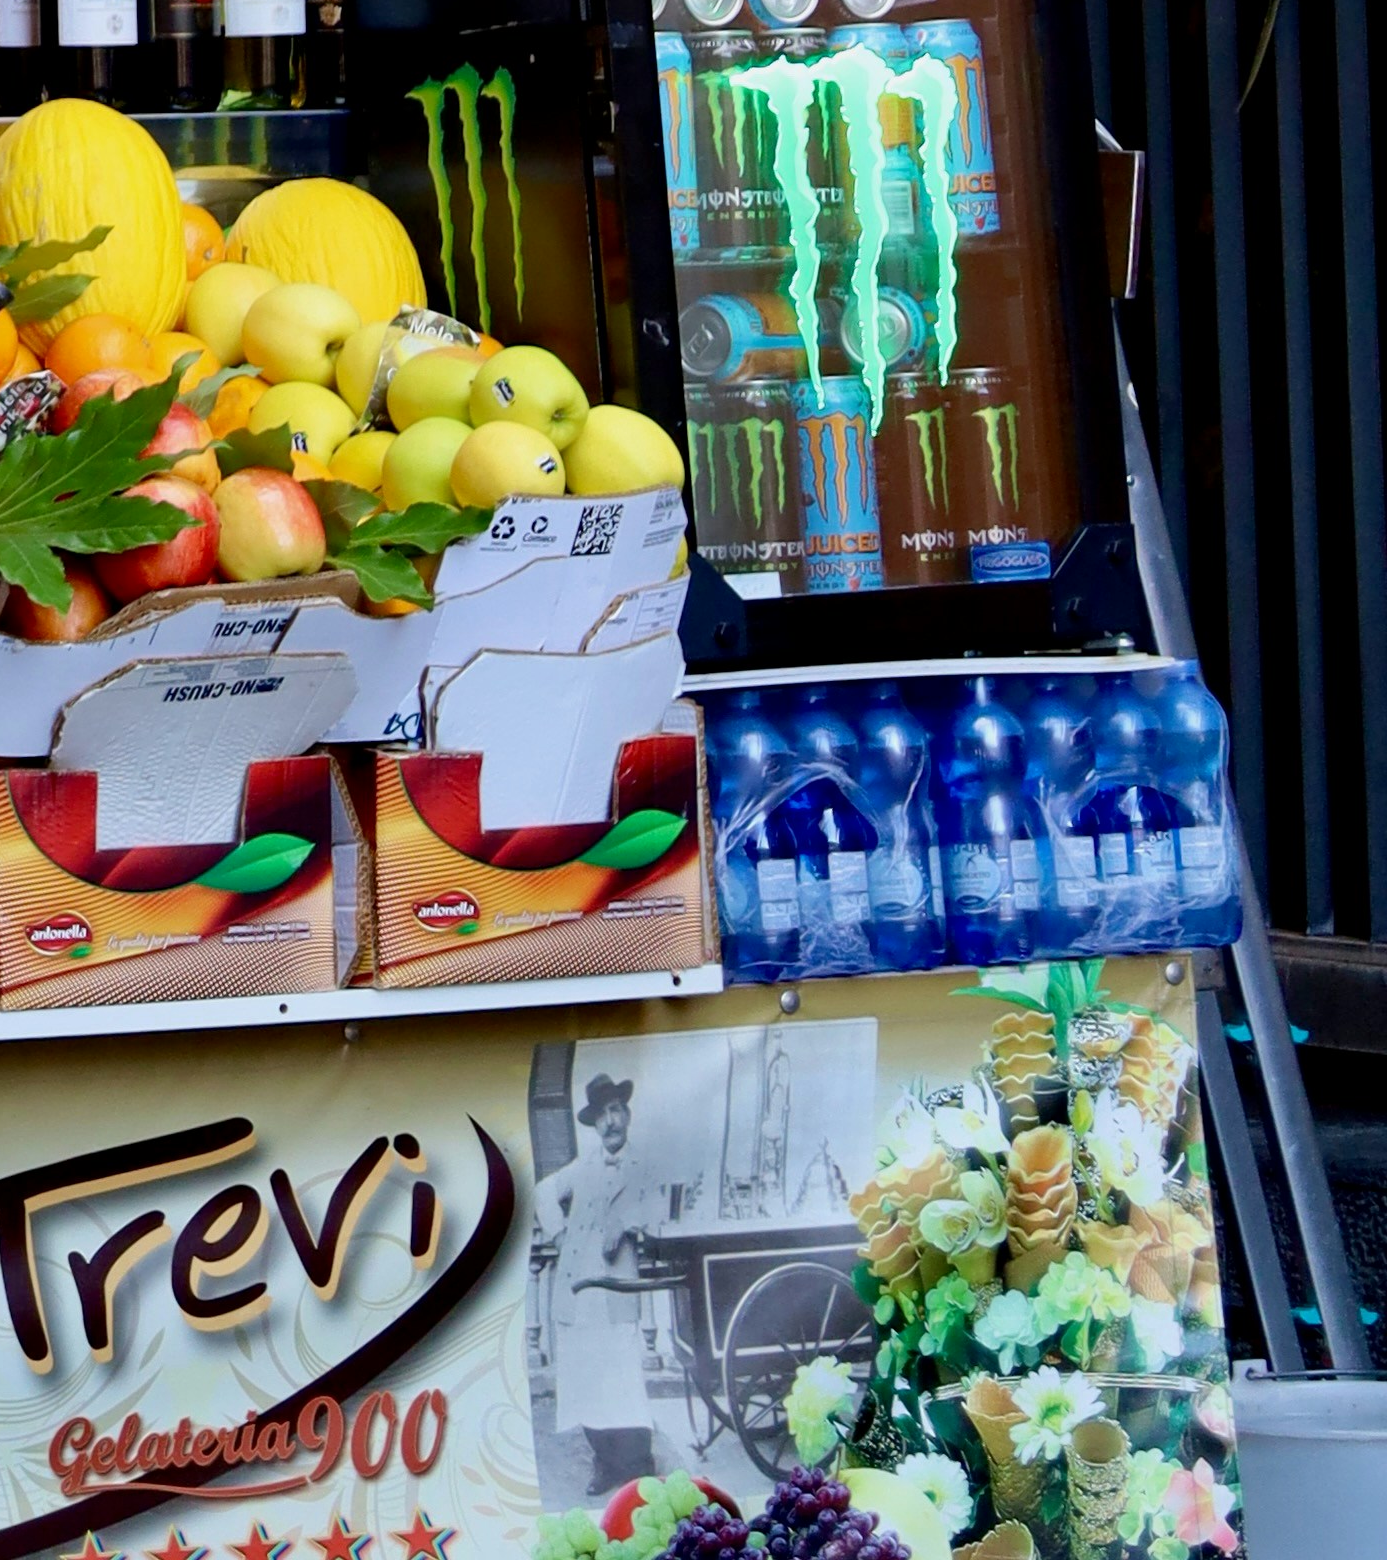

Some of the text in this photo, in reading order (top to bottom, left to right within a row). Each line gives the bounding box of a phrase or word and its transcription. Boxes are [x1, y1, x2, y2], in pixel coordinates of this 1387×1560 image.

[212, 617, 285, 638] NO-CRU
[163, 679, 259, 704] NO-CRUSH
[417, 901, 476, 920] antonella
[30, 922, 88, 941] antonella
[50, 1388, 449, 1492] Gelateria 900
